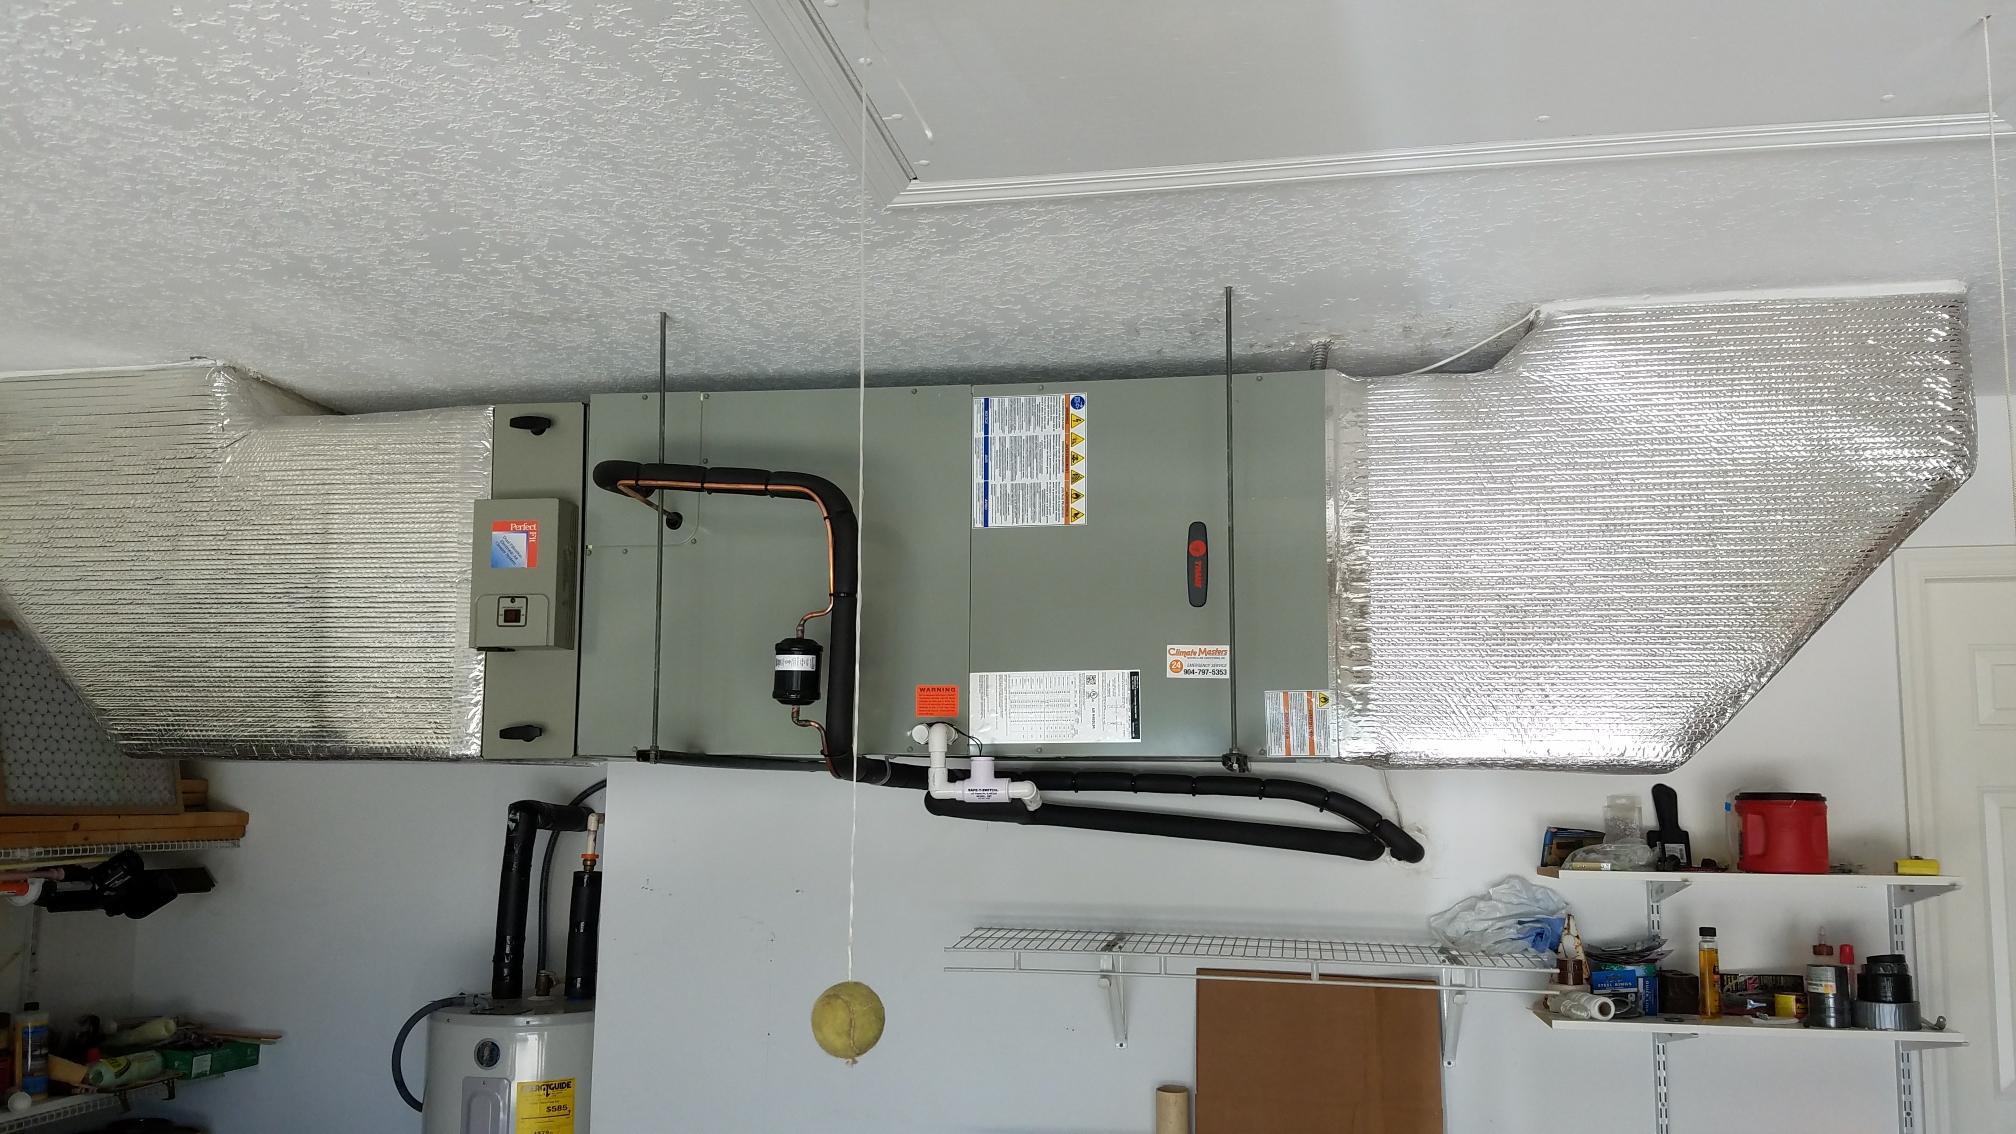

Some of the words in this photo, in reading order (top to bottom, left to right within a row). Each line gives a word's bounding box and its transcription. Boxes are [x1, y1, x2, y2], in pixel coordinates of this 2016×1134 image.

[510, 522, 537, 530] Perfect
[1168, 648, 1198, 658] Climate
[1198, 648, 1228, 656] Masters
[521, 1081, 572, 1097] ERGYGUIDE
